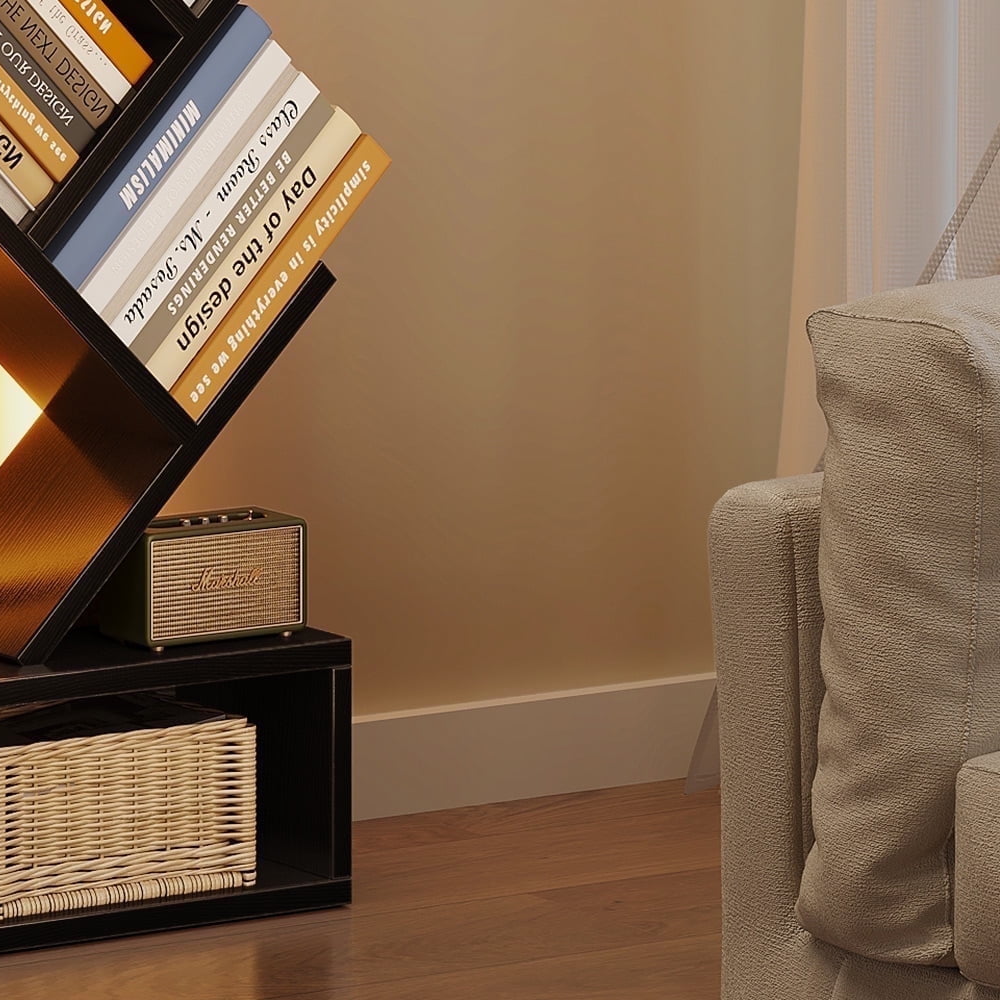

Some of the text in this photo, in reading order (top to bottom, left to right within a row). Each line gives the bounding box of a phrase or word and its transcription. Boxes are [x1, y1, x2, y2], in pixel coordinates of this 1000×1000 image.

[118, 99, 201, 210] MINIMALISM
[259, 99, 298, 146] Class
[216, 148, 260, 202] Room
[167, 150, 292, 315] BE BETTER RENDERINGS
[174, 219, 203, 251] Ms.
[176, 165, 317, 351] Day of the design
[123, 256, 178, 324] Posada
[189, 160, 371, 403] simplicity is in everything we see
